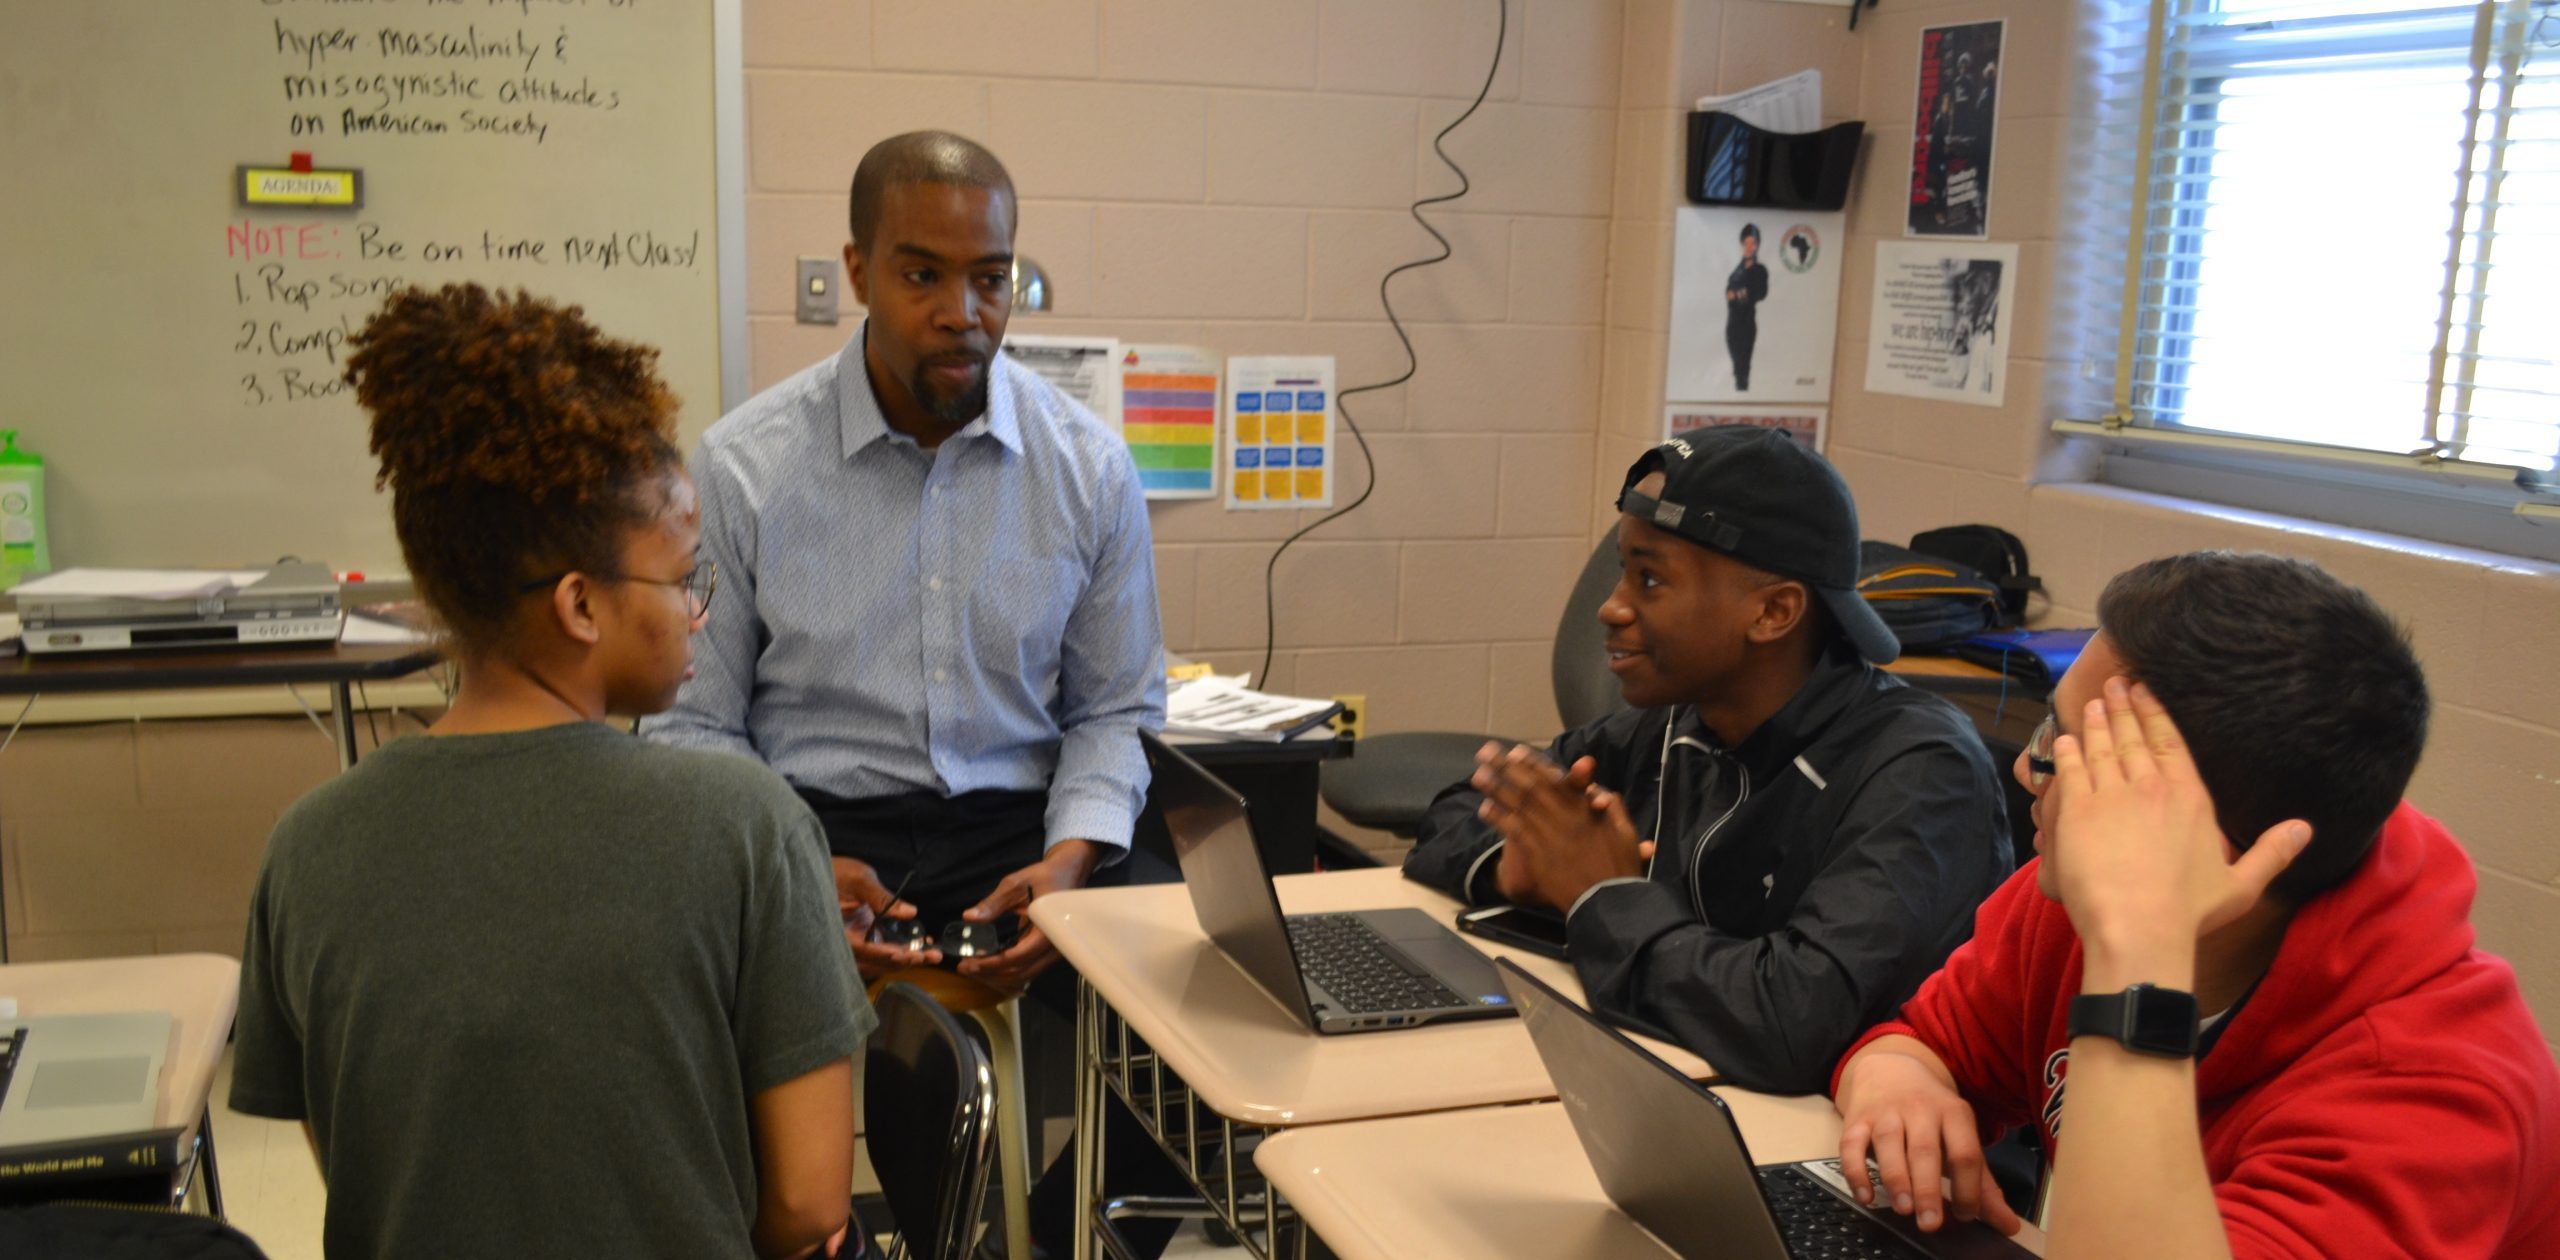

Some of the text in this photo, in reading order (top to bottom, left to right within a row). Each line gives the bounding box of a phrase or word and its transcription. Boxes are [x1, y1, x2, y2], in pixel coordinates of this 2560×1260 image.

[275, 18, 357, 70] hyper
[379, 25, 540, 73] masculinity
[284, 70, 621, 111] misogynistic attitudes
[291, 111, 324, 136] on
[342, 107, 447, 137] American
[227, 217, 343, 263] NOTE:
[356, 222, 406, 261] Be
[423, 241, 464, 262] on
[481, 228, 549, 265] time
[257, 262, 320, 313] Rap
[22, 1158, 59, 1176] World
[62, 1156, 84, 1170] and
